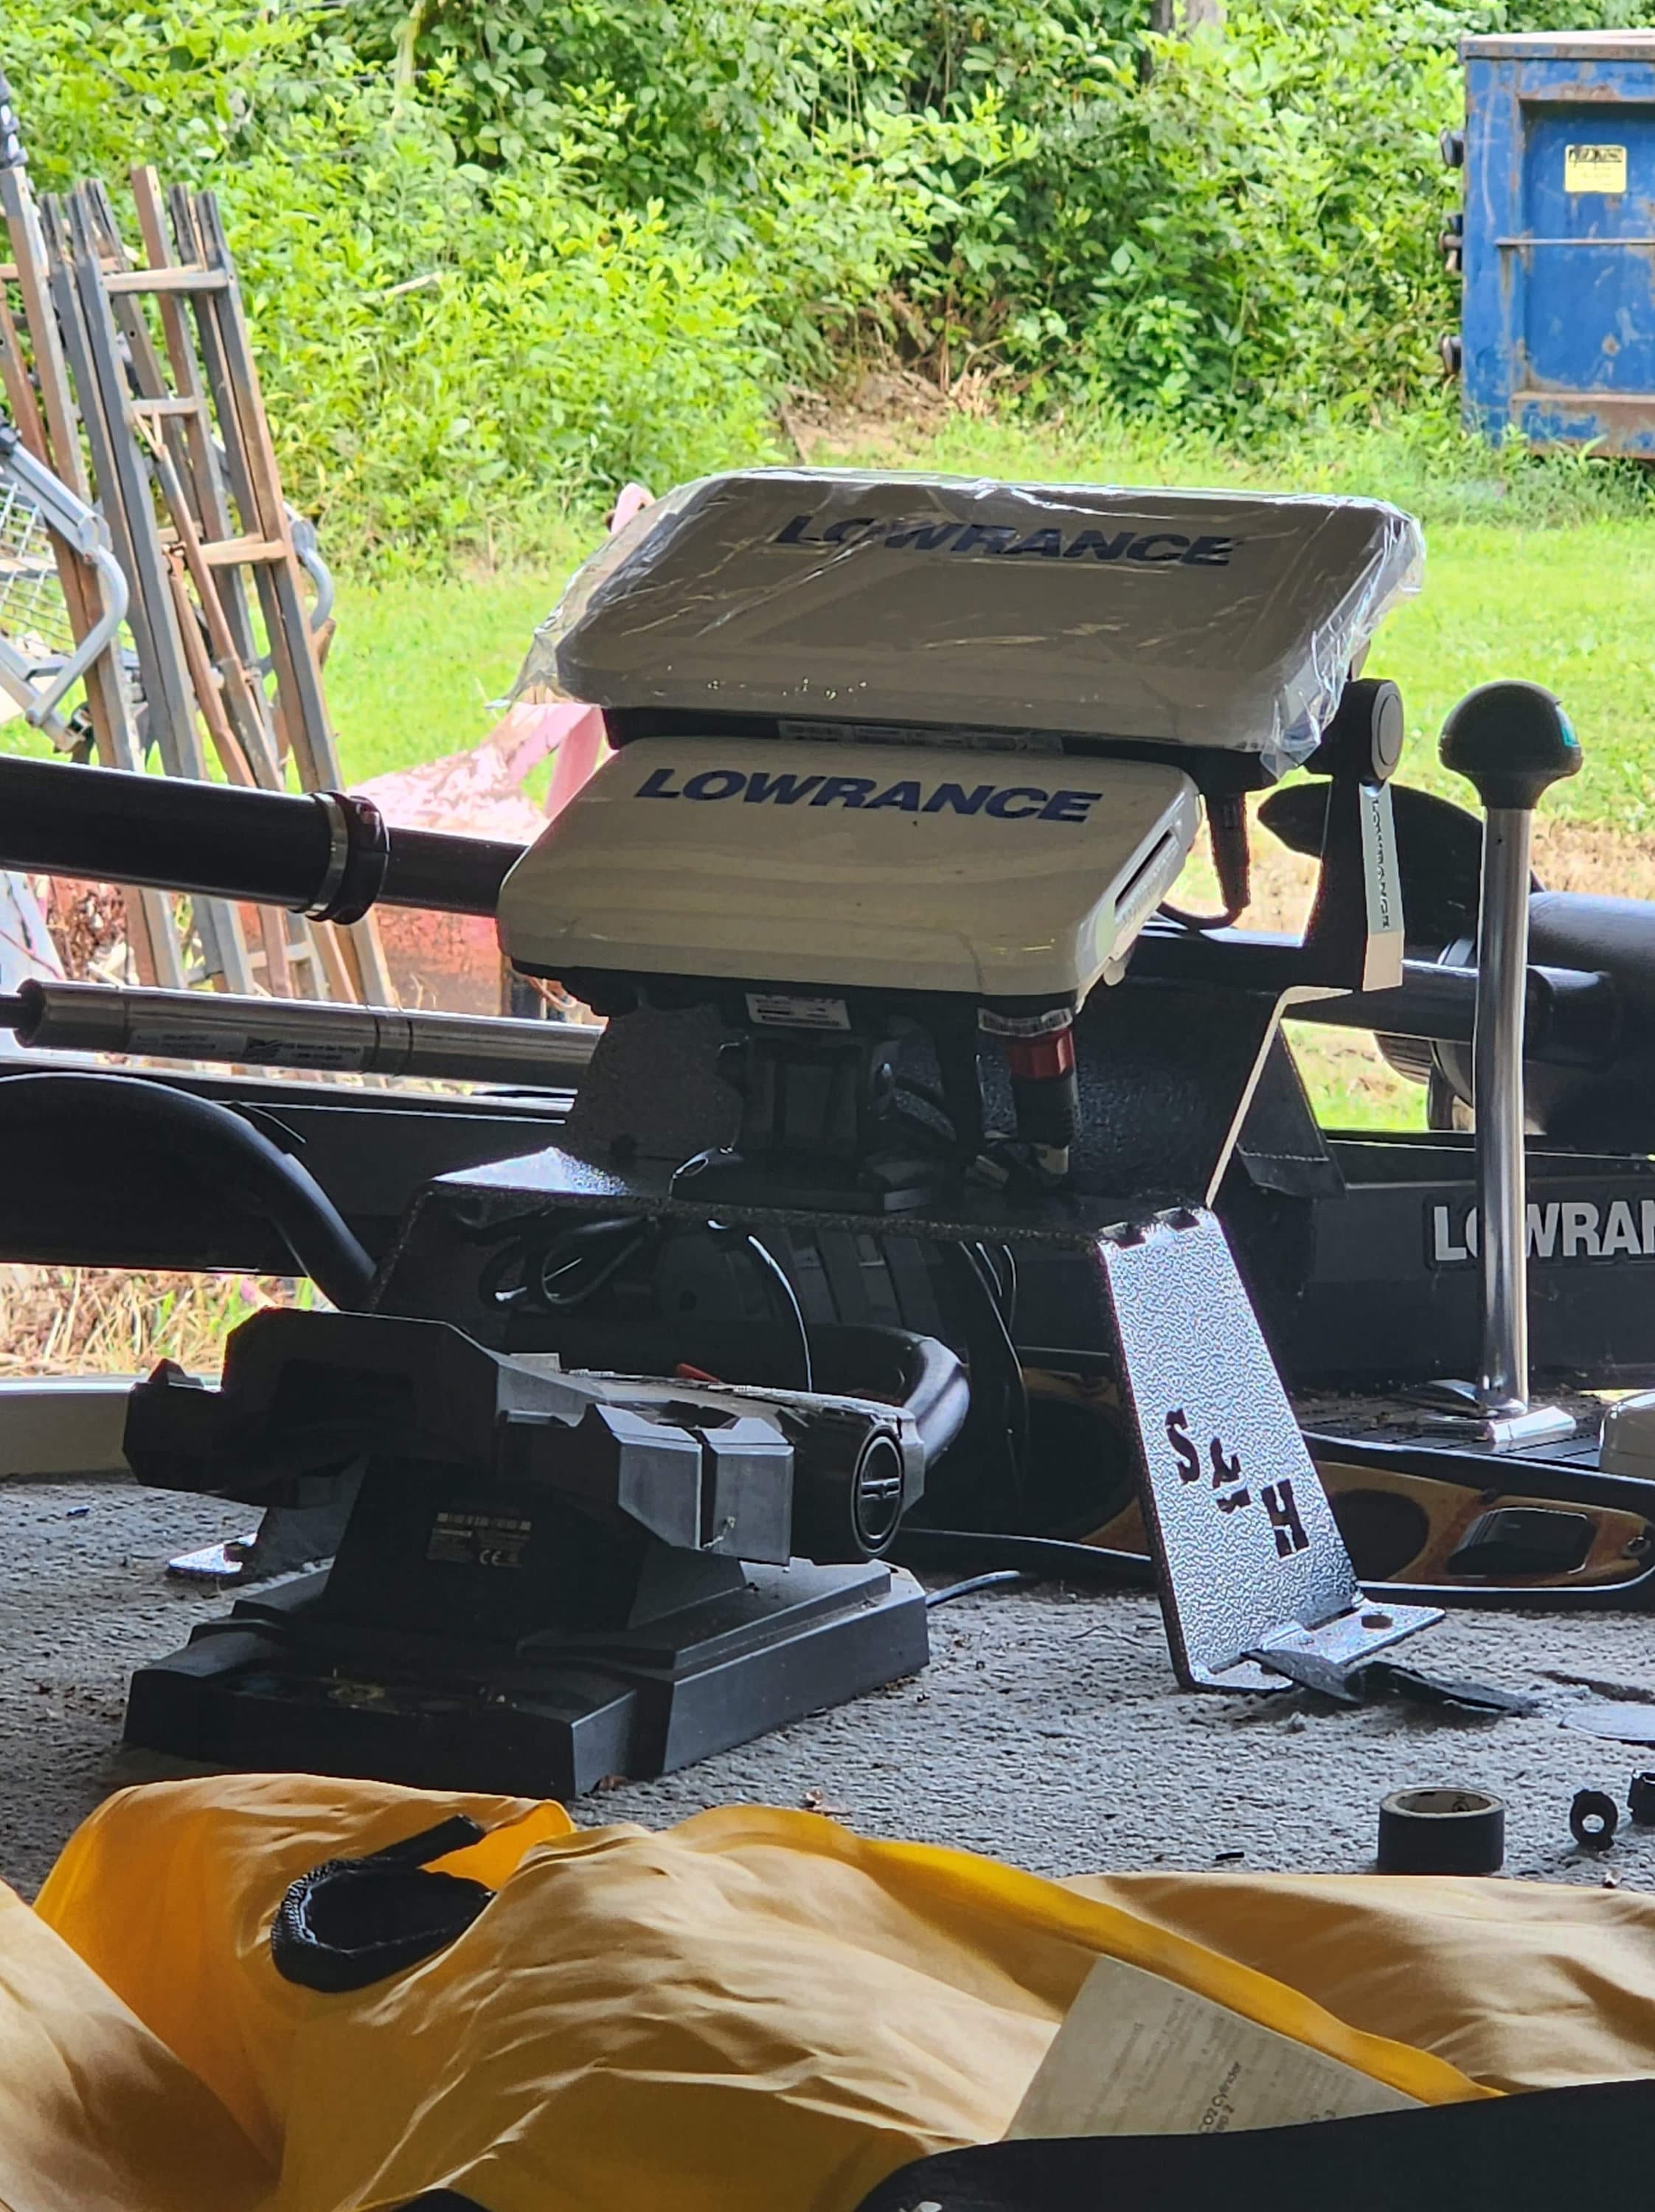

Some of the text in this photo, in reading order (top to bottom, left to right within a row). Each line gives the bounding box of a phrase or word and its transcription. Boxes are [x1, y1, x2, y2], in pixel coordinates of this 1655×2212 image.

[776, 515, 1239, 566] LOWRANCE
[634, 768, 1103, 823] LOWRANCE
[1371, 799, 1390, 928] LOWRANCE
